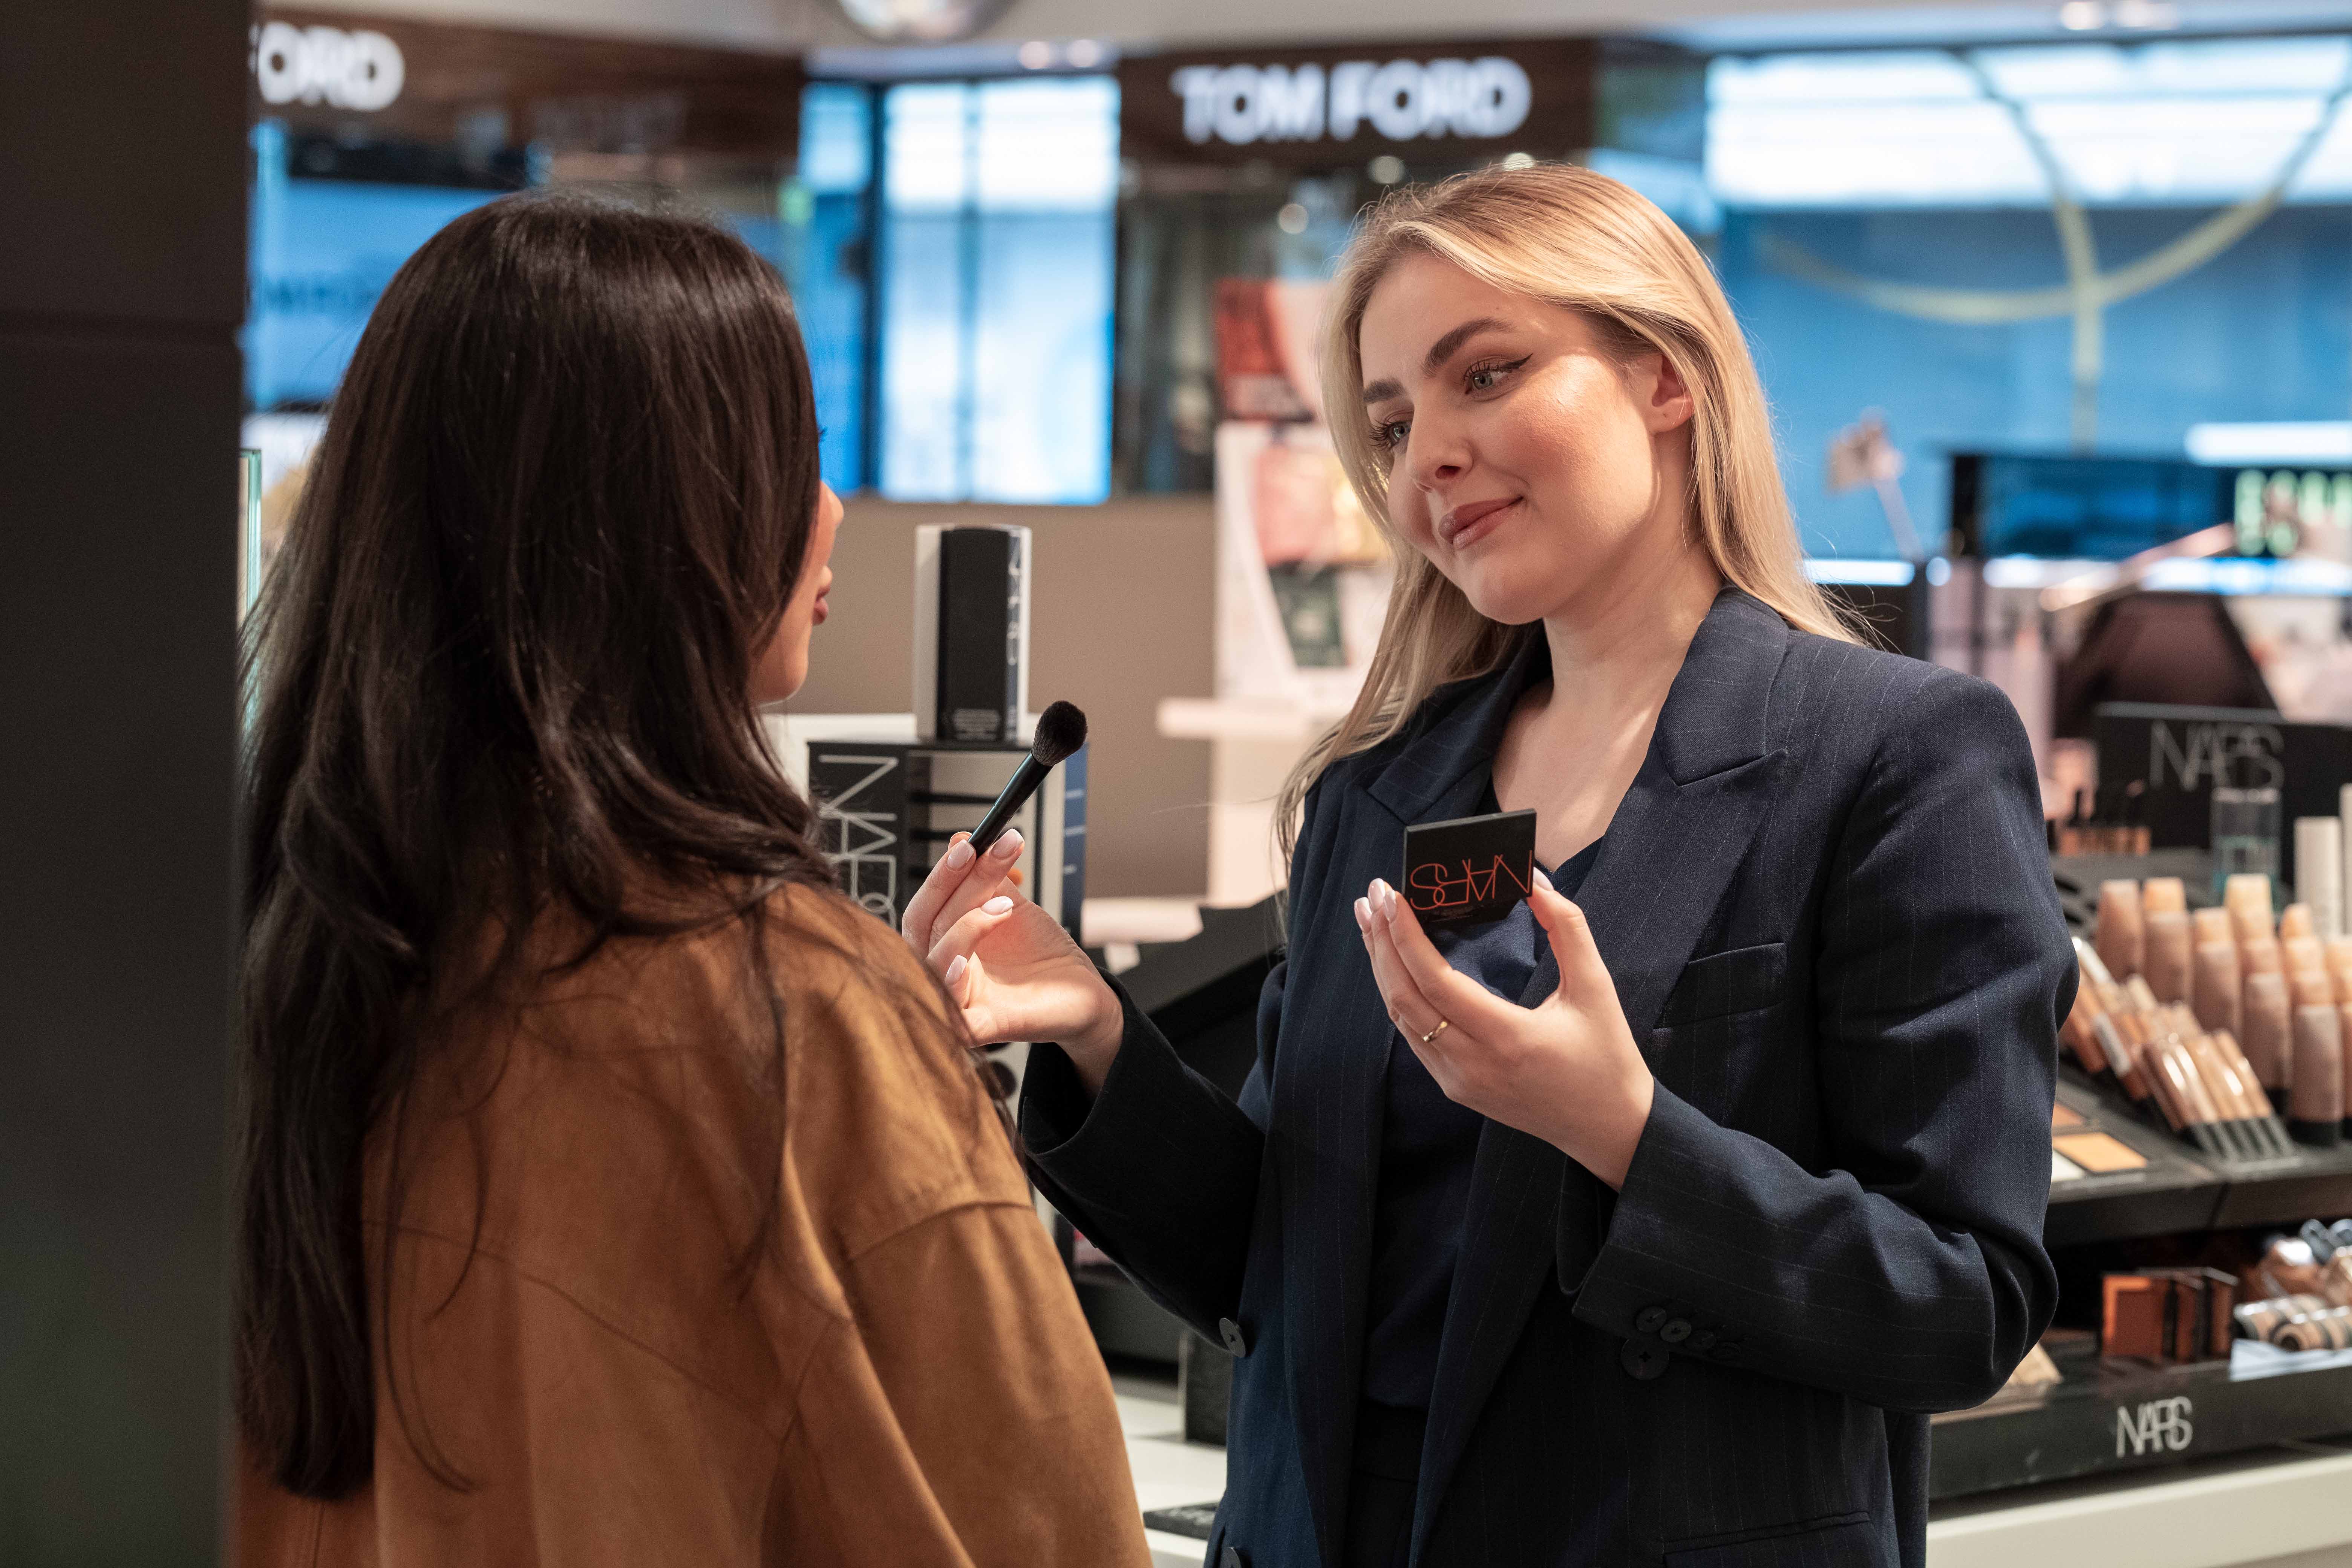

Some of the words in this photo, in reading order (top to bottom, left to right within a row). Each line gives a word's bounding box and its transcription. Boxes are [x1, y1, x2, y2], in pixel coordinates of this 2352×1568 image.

[250, 20, 406, 112] ORD
[1170, 63, 1326, 144] TOM
[1329, 57, 1532, 141] FORD
[2150, 720, 2285, 790] NARS
[1410, 850, 1533, 911] NARS
[2116, 1396, 2193, 1459] NARS
